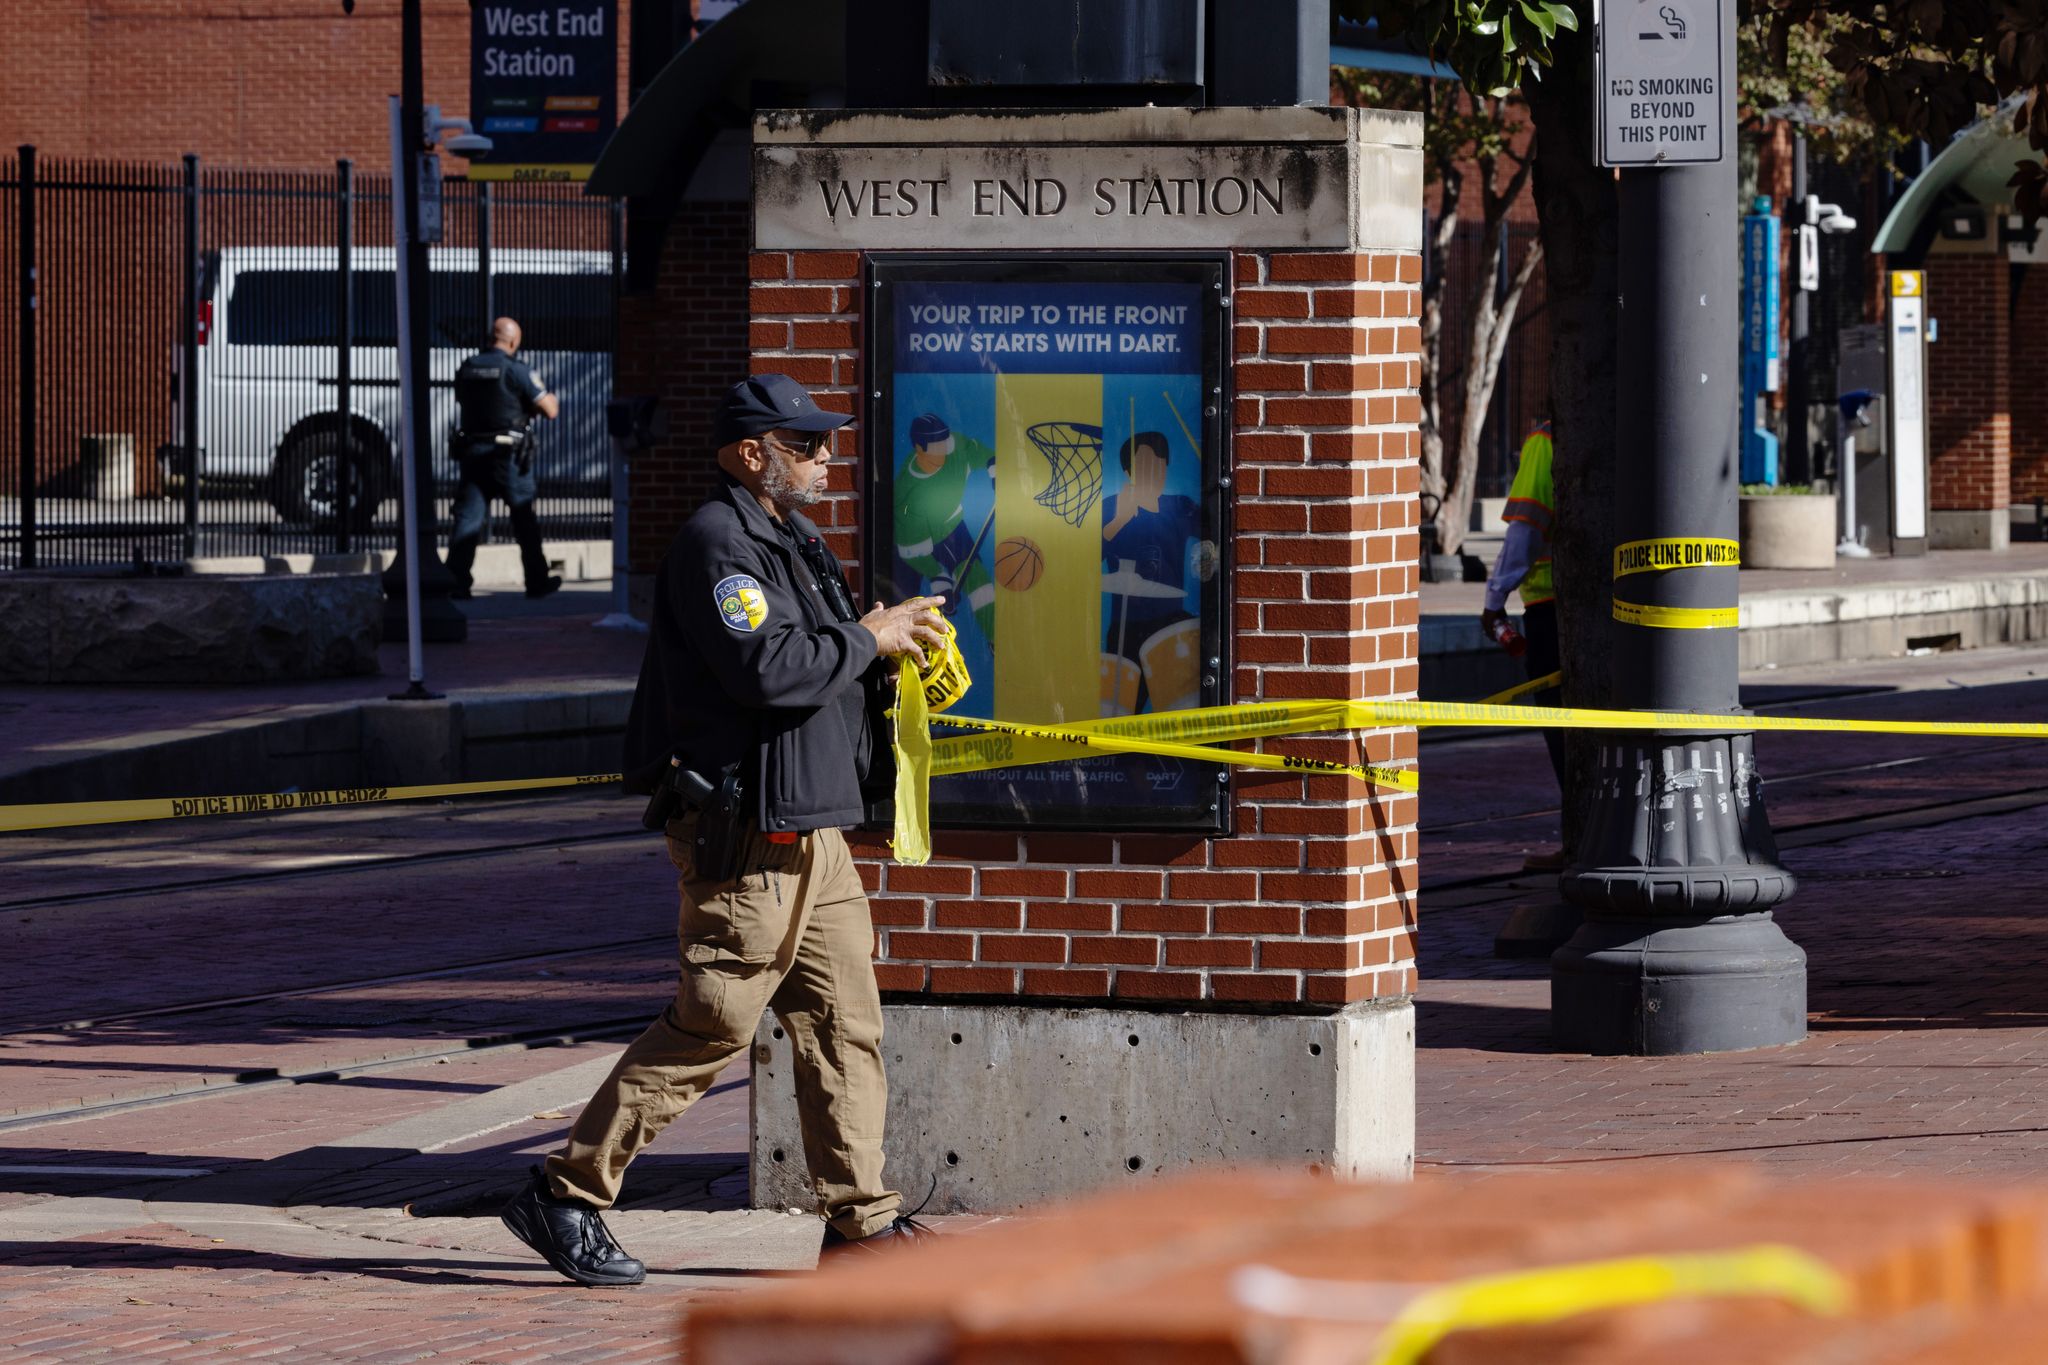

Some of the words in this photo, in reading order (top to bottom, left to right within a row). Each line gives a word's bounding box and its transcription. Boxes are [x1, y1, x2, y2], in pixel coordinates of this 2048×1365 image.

[484, 7, 549, 36] West
[557, 7, 603, 36] End
[484, 47, 575, 76] Station
[1611, 80, 1634, 96] NO
[1639, 78, 1713, 96] SMOKING
[1631, 102, 1695, 119] BEYOND
[1619, 126, 1654, 142] THIS
[1660, 125, 1707, 142] POINT
[819, 178, 947, 219] WEST
[973, 178, 1067, 218] END
[1094, 176, 1285, 218] STATION
[1752, 224, 1763, 352] ASSISTANCE
[909, 305, 971, 324] YOUR
[978, 305, 1024, 324] TRIP
[1030, 306, 1061, 324] TO
[1067, 306, 1107, 324] THE
[1114, 306, 1188, 324] FRONT
[910, 333, 964, 352] ROW
[970, 333, 1049, 353] STARTS
[1055, 334, 1111, 352] WITH
[1119, 334, 1181, 352] DART.
[1620, 545, 1651, 571] POLICE
[1654, 544, 1681, 564] LINE
[1685, 544, 1703, 564] DO
[1706, 544, 1726, 562] NOT
[717, 580, 754, 598] POLICE
[967, 771, 1021, 781] WITHOUT
[1025, 771, 1046, 781] ALL
[1051, 771, 1071, 781] THE
[1146, 772, 1177, 781] DART
